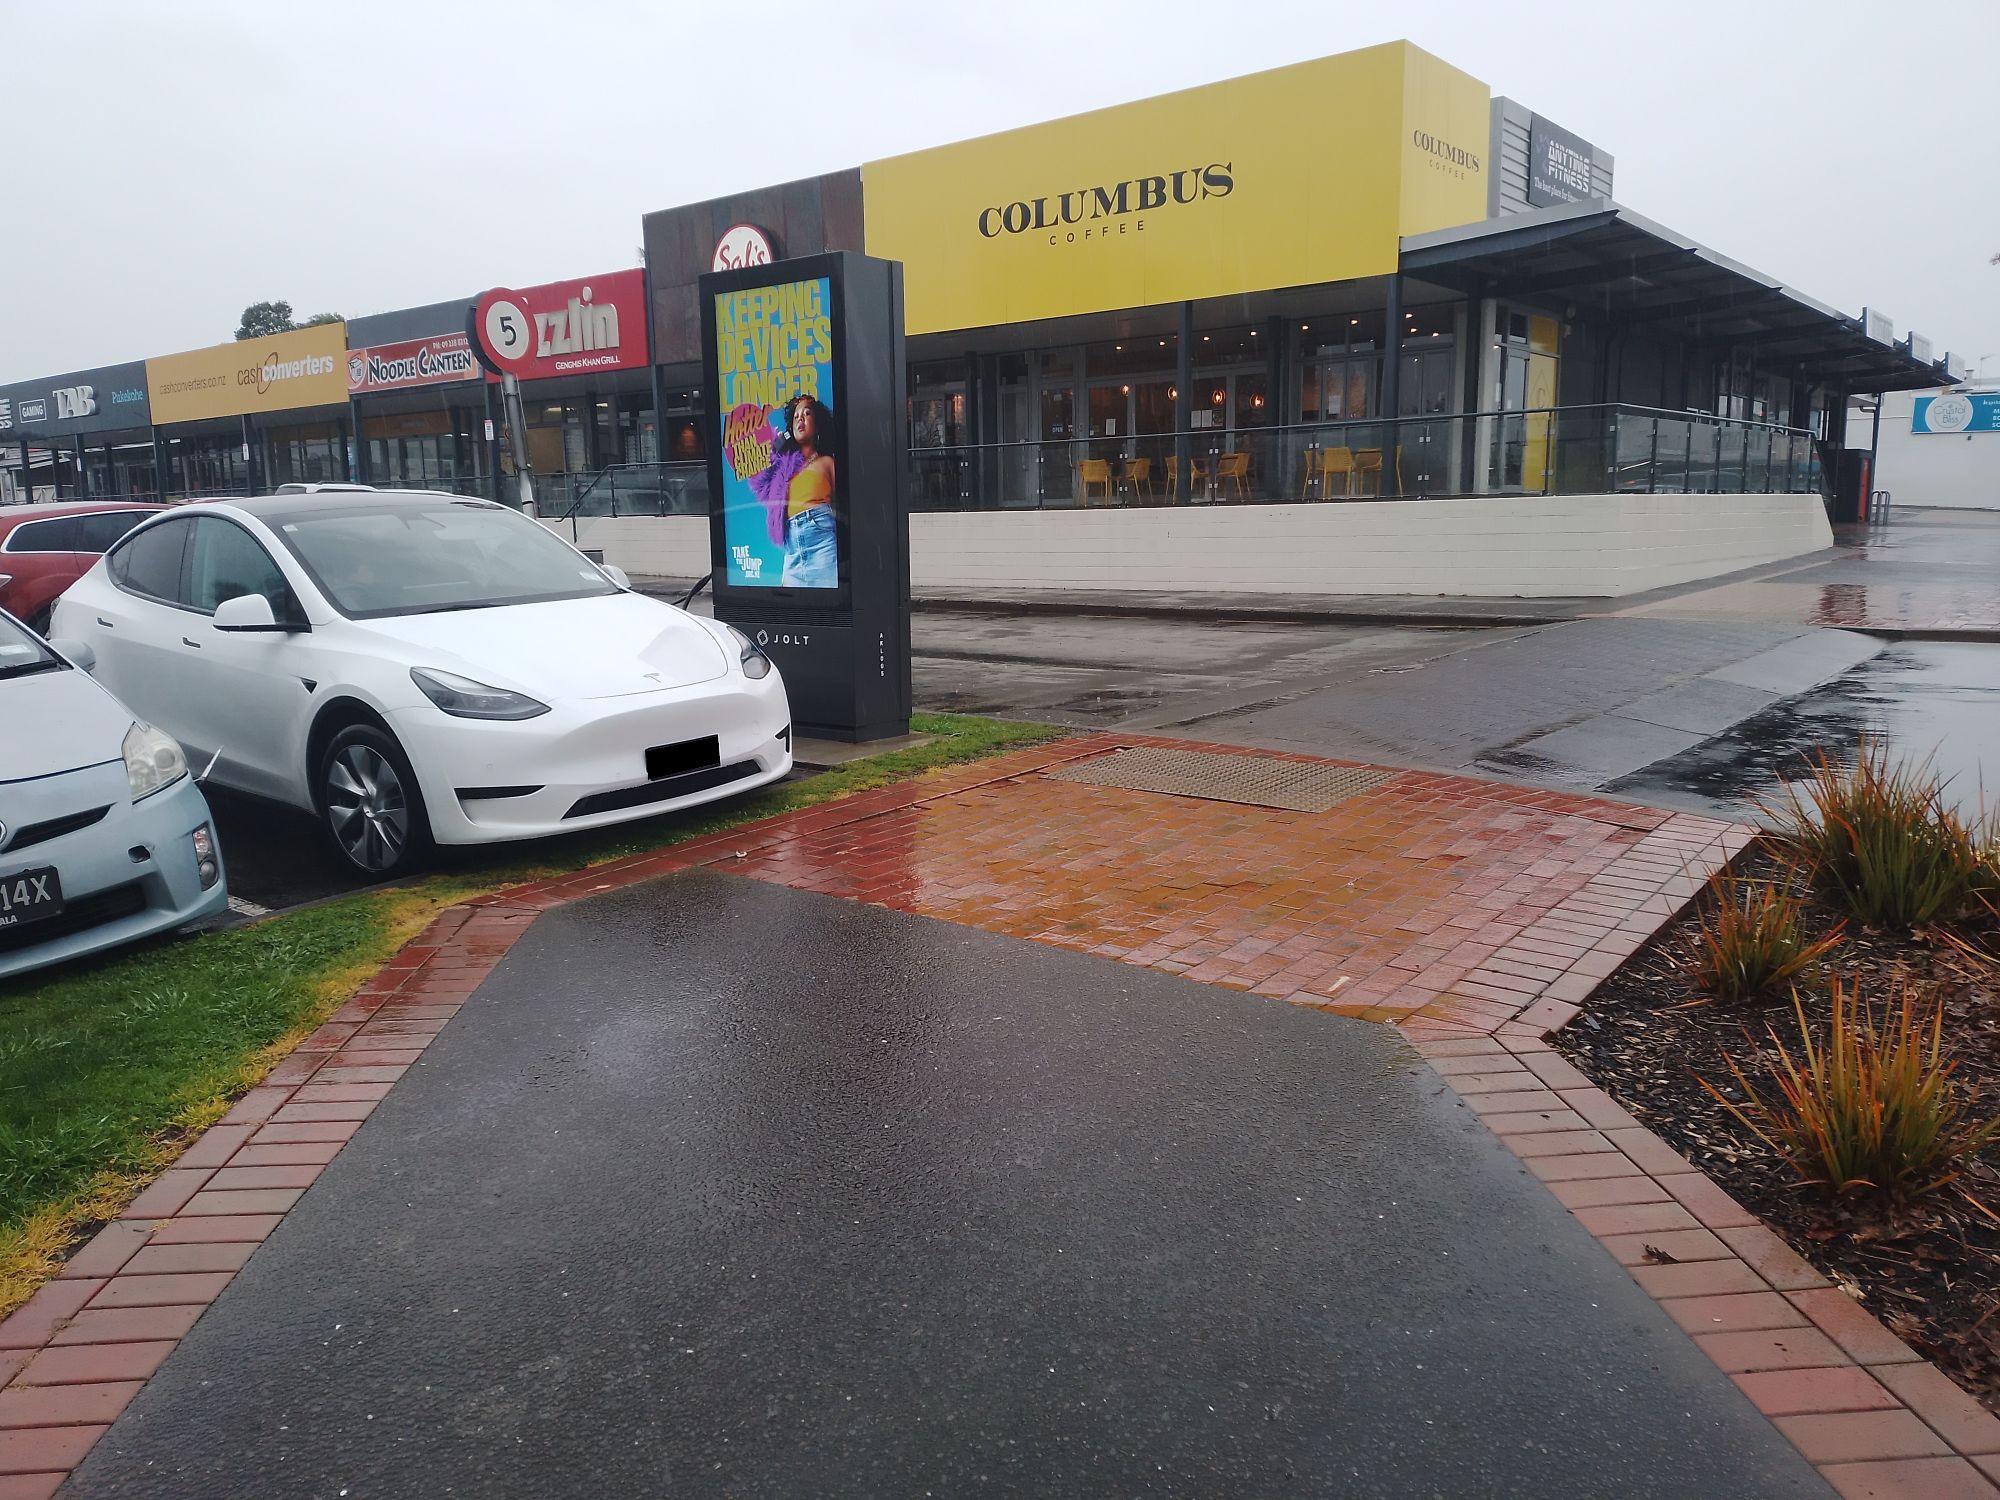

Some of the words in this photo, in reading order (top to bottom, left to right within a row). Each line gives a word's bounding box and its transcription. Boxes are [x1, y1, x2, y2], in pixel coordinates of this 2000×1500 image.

[1413, 130, 1479, 173] COLUMBUS
[1548, 140, 1590, 177] ANYTIME
[1429, 159, 1465, 181] COFFEE
[1548, 160, 1590, 193] FITNESS
[978, 162, 1234, 238] COLUMBUS
[1049, 220, 1145, 246] COFFEE
[533, 286, 620, 358] zzlin
[715, 280, 821, 334] KEEPING
[499, 316, 517, 346] 5
[717, 316, 831, 374] DEVICES
[368, 356, 417, 385] NOODLE
[417, 347, 472, 377] CANTEEN
[555, 360, 582, 370] GENGHIS
[582, 357, 600, 367] KHAN
[600, 355, 620, 365] GRILL
[160, 375, 226, 395] cashconverters.co.nz
[720, 366, 818, 413] LONGER
[22, 405, 43, 417] GAMING
[52, 386, 97, 419] TAB
[732, 545, 750, 558] TAKE
[742, 557, 762, 571] JUMP
[774, 634, 809, 645] JOLT
